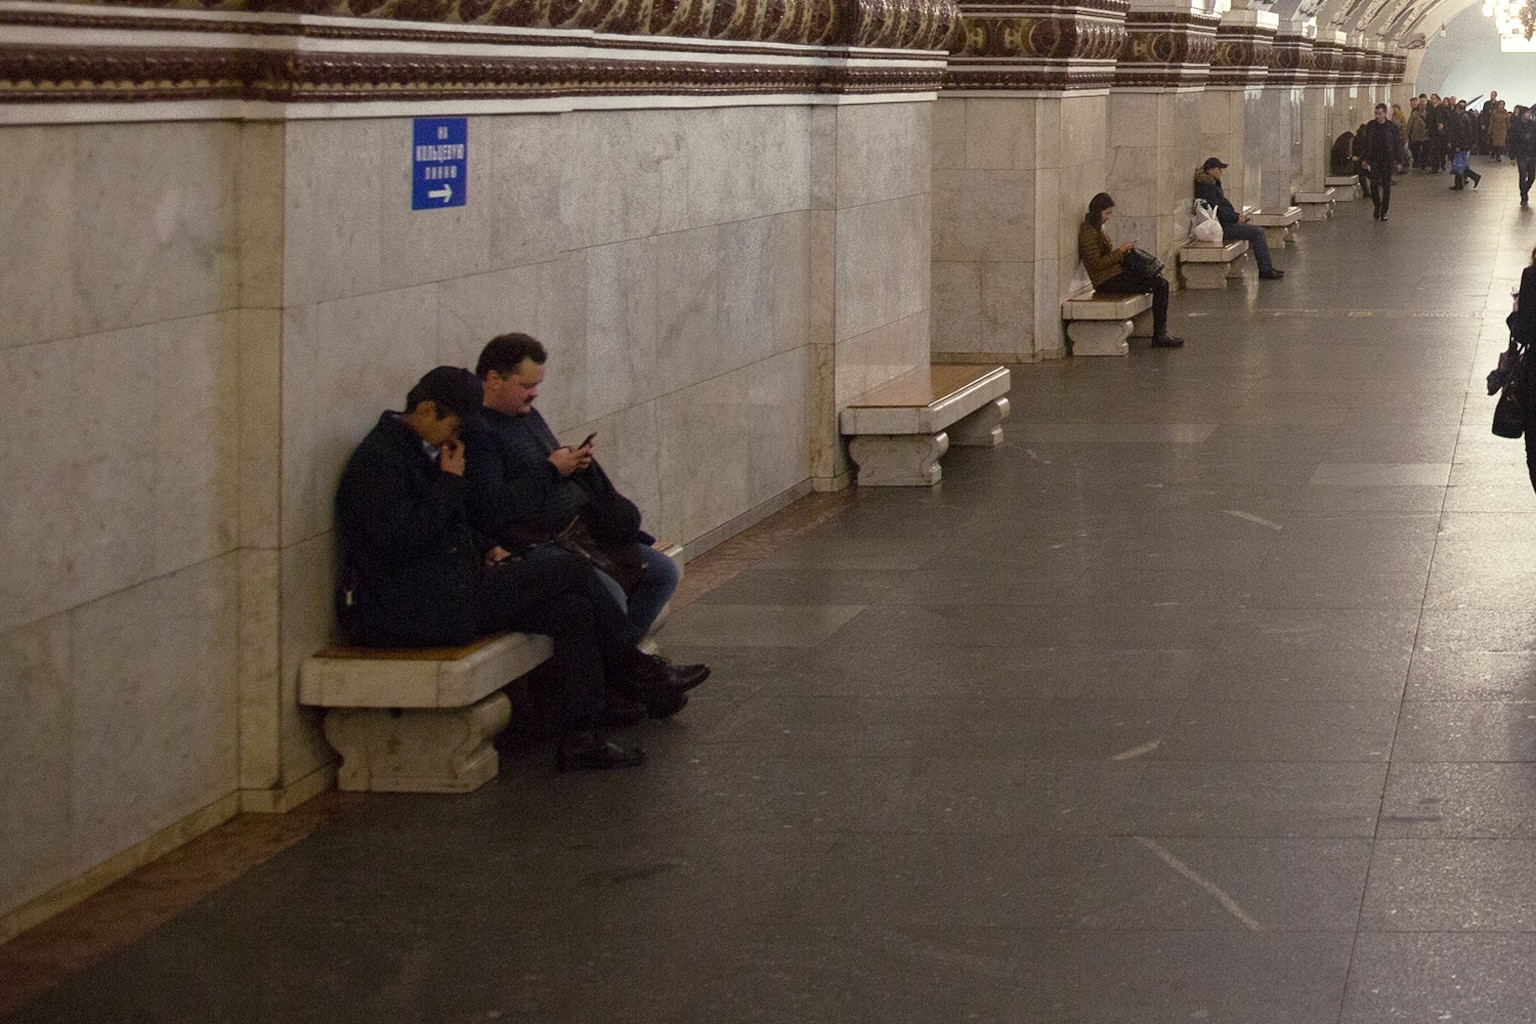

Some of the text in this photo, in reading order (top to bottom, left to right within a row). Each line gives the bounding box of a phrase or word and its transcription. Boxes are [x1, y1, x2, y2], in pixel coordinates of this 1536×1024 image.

[437, 126, 448, 139] НА
[416, 143, 464, 163] КОЛЬЦЕВУЮ
[425, 165, 458, 180] ЛИНИЮ
